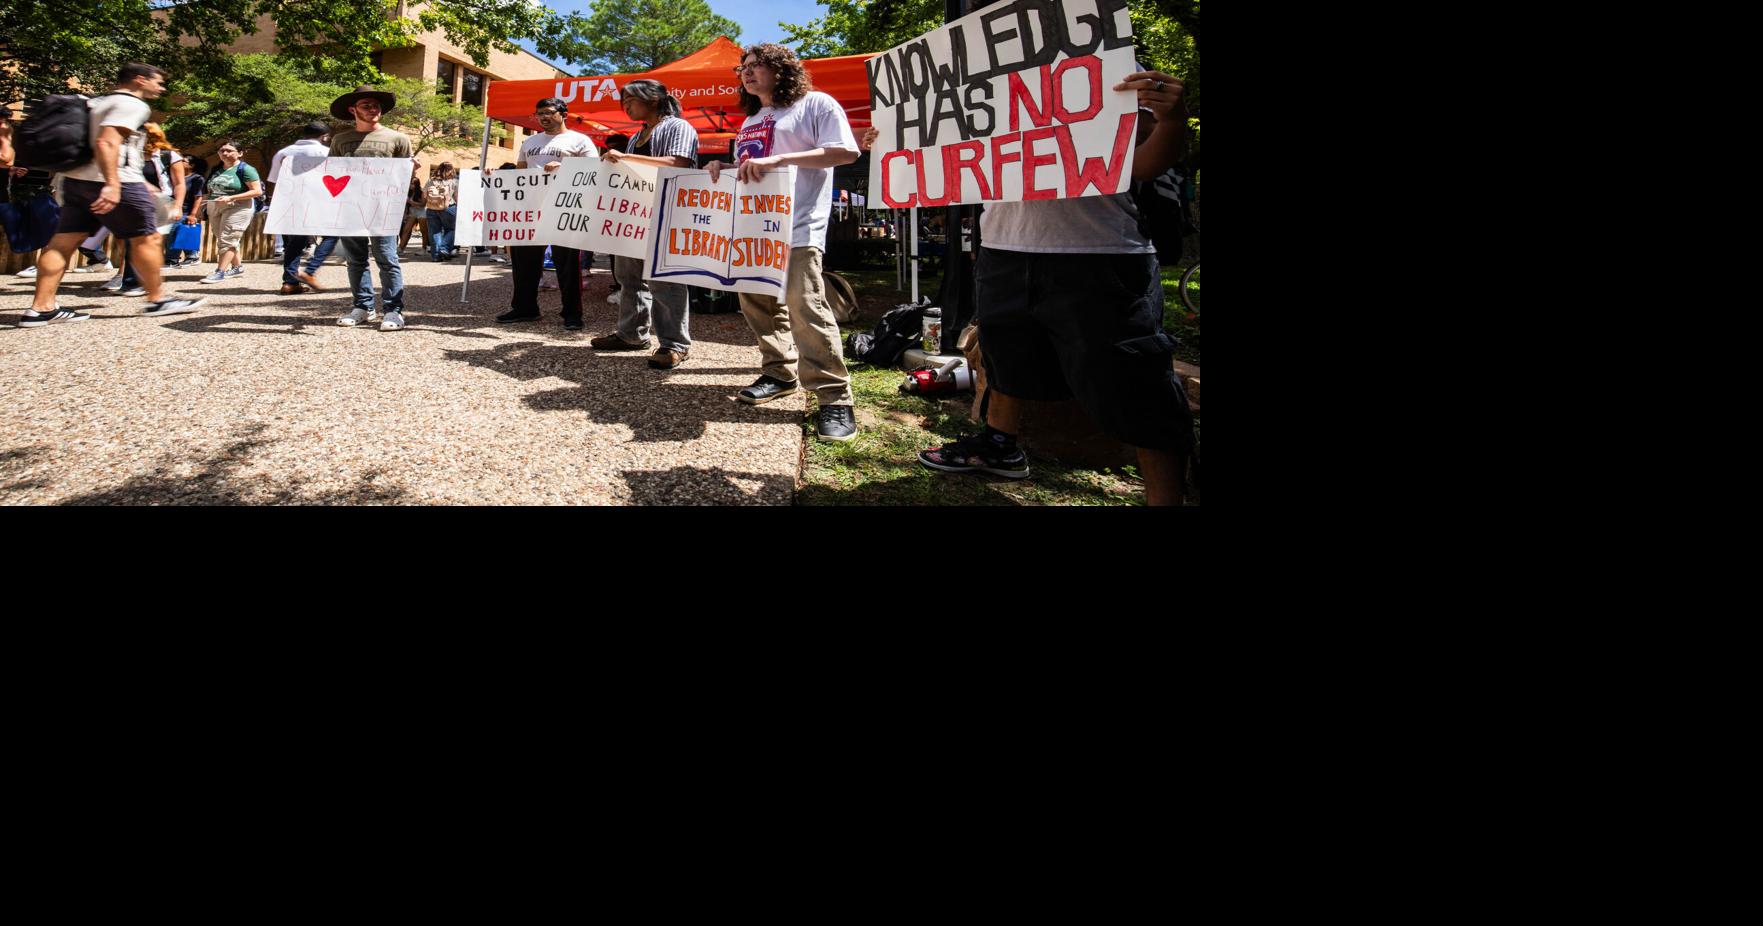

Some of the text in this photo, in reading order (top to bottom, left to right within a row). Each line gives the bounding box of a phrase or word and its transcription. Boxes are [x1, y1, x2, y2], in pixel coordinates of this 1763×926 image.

[865, 0, 1134, 111] KNOWLEDGE
[553, 78, 621, 103] UTA
[689, 85, 715, 97] and
[896, 54, 1104, 150] HAS NO
[881, 112, 1137, 208] CURFEW
[481, 173, 556, 188] NO CUT
[572, 171, 654, 192] OUR CAMPU
[501, 190, 524, 200] TO
[555, 192, 583, 208] OUR
[676, 187, 732, 213] REOPEN
[740, 194, 791, 215] INVES
[557, 212, 650, 240] OUR RIGH
[692, 213, 712, 225] THE
[763, 219, 780, 232] IN
[669, 228, 732, 263] LIBRARY
[732, 237, 790, 272] STUDEN
